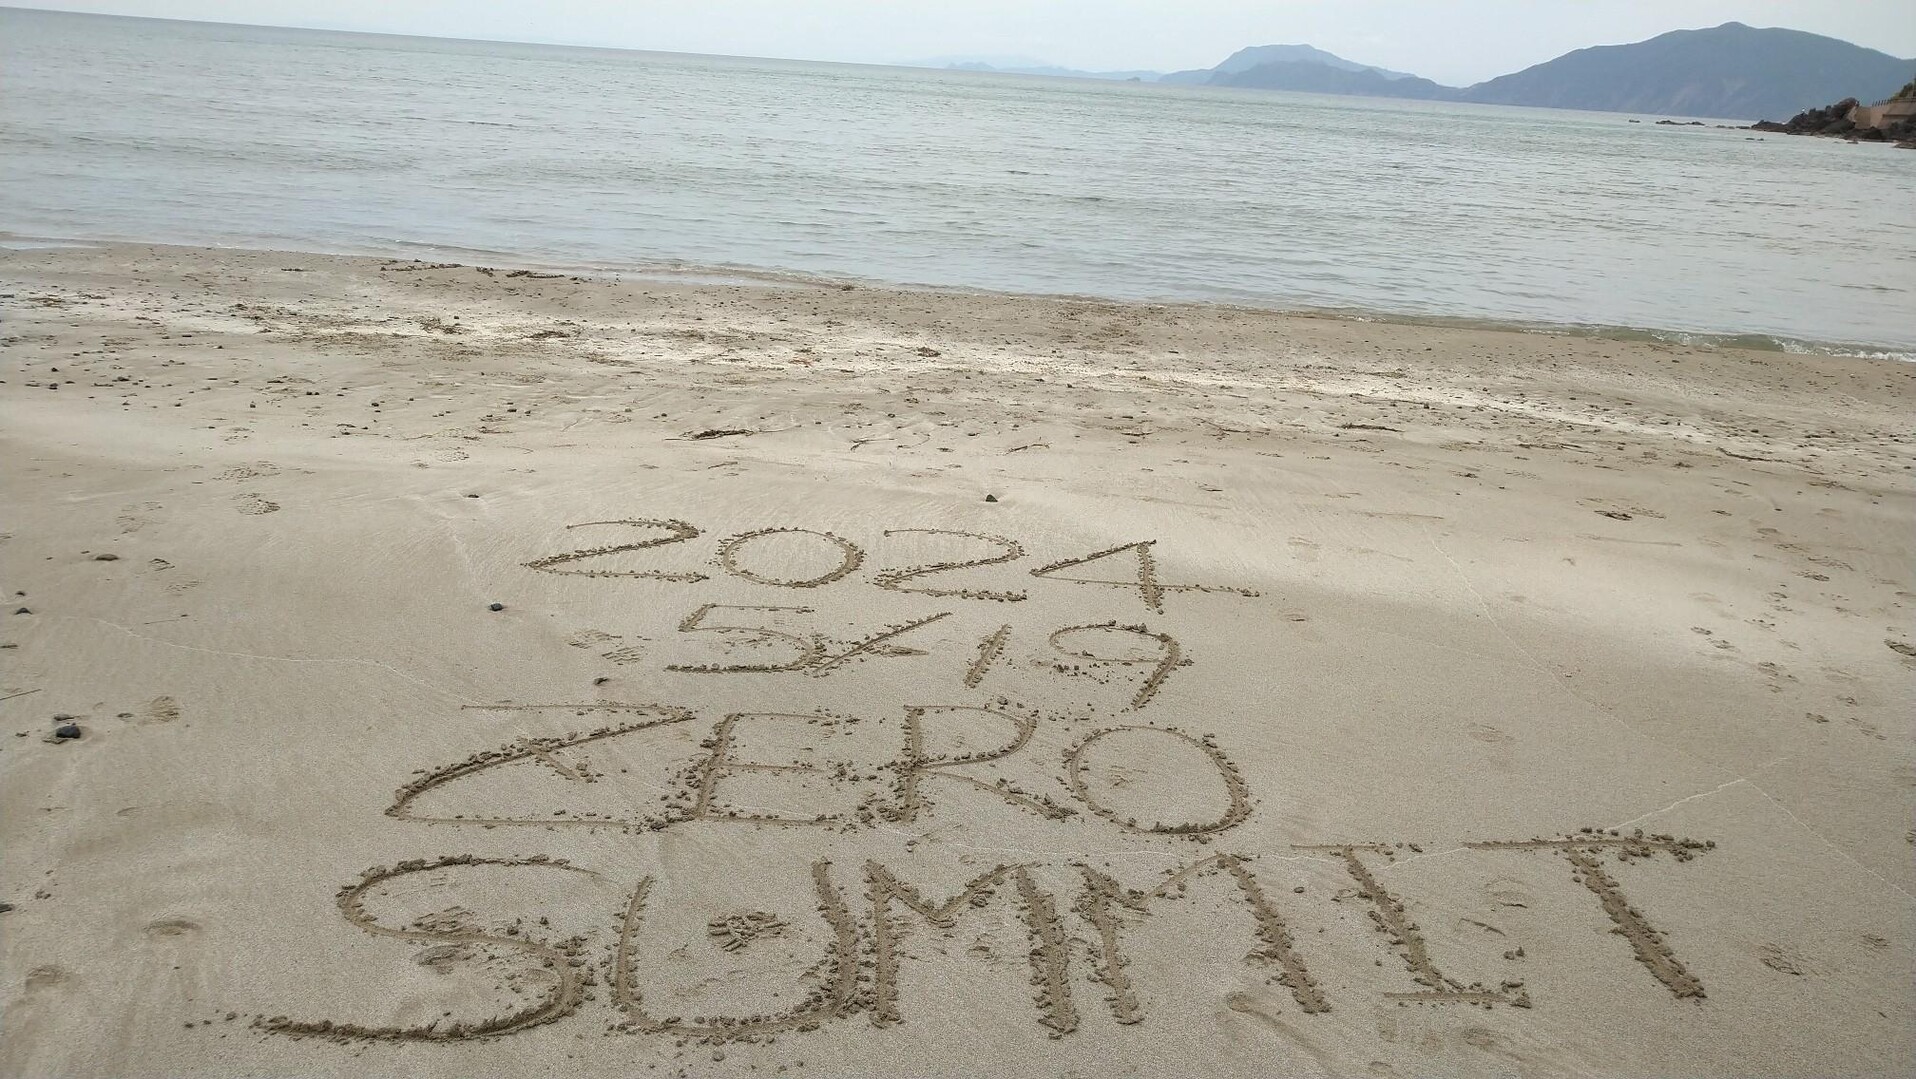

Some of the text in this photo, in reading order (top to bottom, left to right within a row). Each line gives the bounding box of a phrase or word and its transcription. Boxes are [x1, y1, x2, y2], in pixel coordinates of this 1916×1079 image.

[523, 517, 1259, 613] 2024
[666, 603, 1191, 709] 5/19
[386, 701, 1254, 838] ZERO
[254, 828, 1716, 1044] SUMMIT
